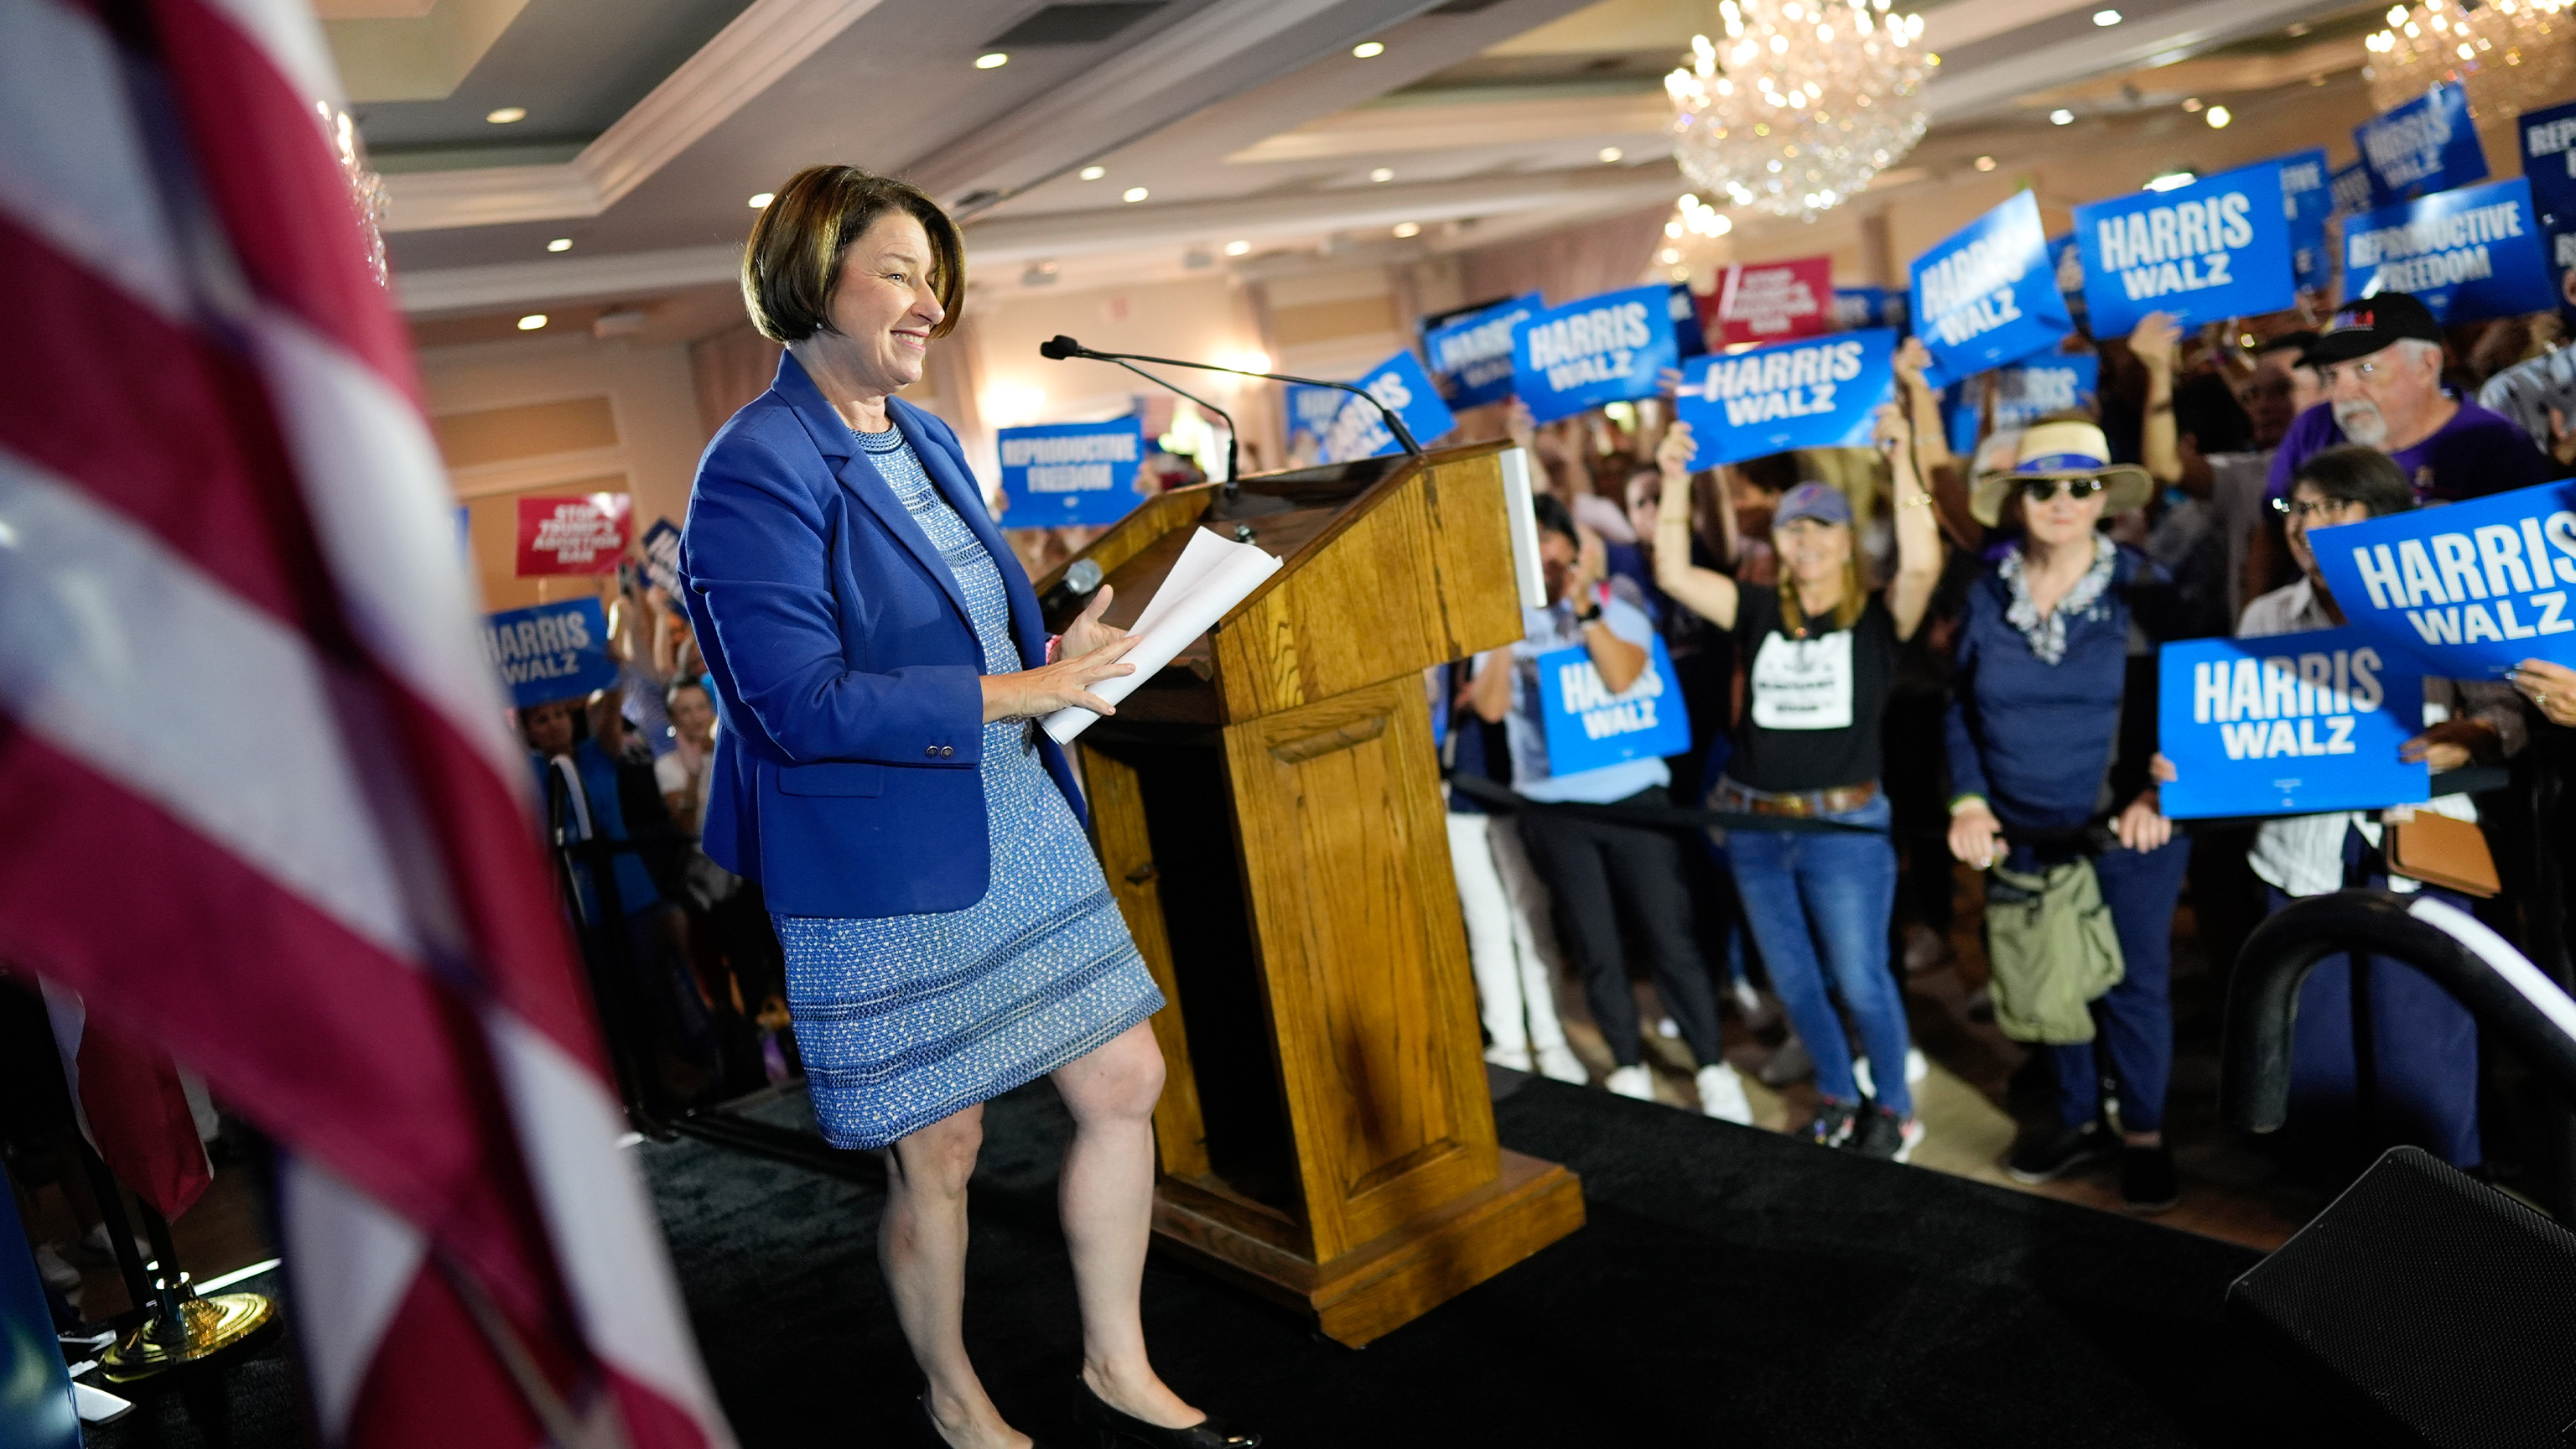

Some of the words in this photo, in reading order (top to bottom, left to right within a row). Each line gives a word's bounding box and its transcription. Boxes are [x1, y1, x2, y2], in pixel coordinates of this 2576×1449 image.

[2098, 191, 2253, 273] HARRIS
[2350, 200, 2523, 268] REPRODUCTIVE
[2122, 252, 2232, 300] WALZ
[2377, 244, 2492, 293] FREEDOM
[1529, 302, 1649, 371] HARRIS
[1938, 287, 2022, 346] WALZ
[1547, 350, 1633, 392] WALZ
[1704, 341, 1863, 402] HARRIS
[1726, 382, 1836, 426] WALZ
[2353, 511, 2576, 610] HARRIS
[2407, 590, 2574, 645] WALZ
[502, 651, 579, 686] WALZ
[1559, 658, 1664, 714] HAS
[2194, 647, 2383, 723] HARRIS
[1581, 698, 1659, 740] WALZ
[2220, 716, 2355, 760] WALZ
